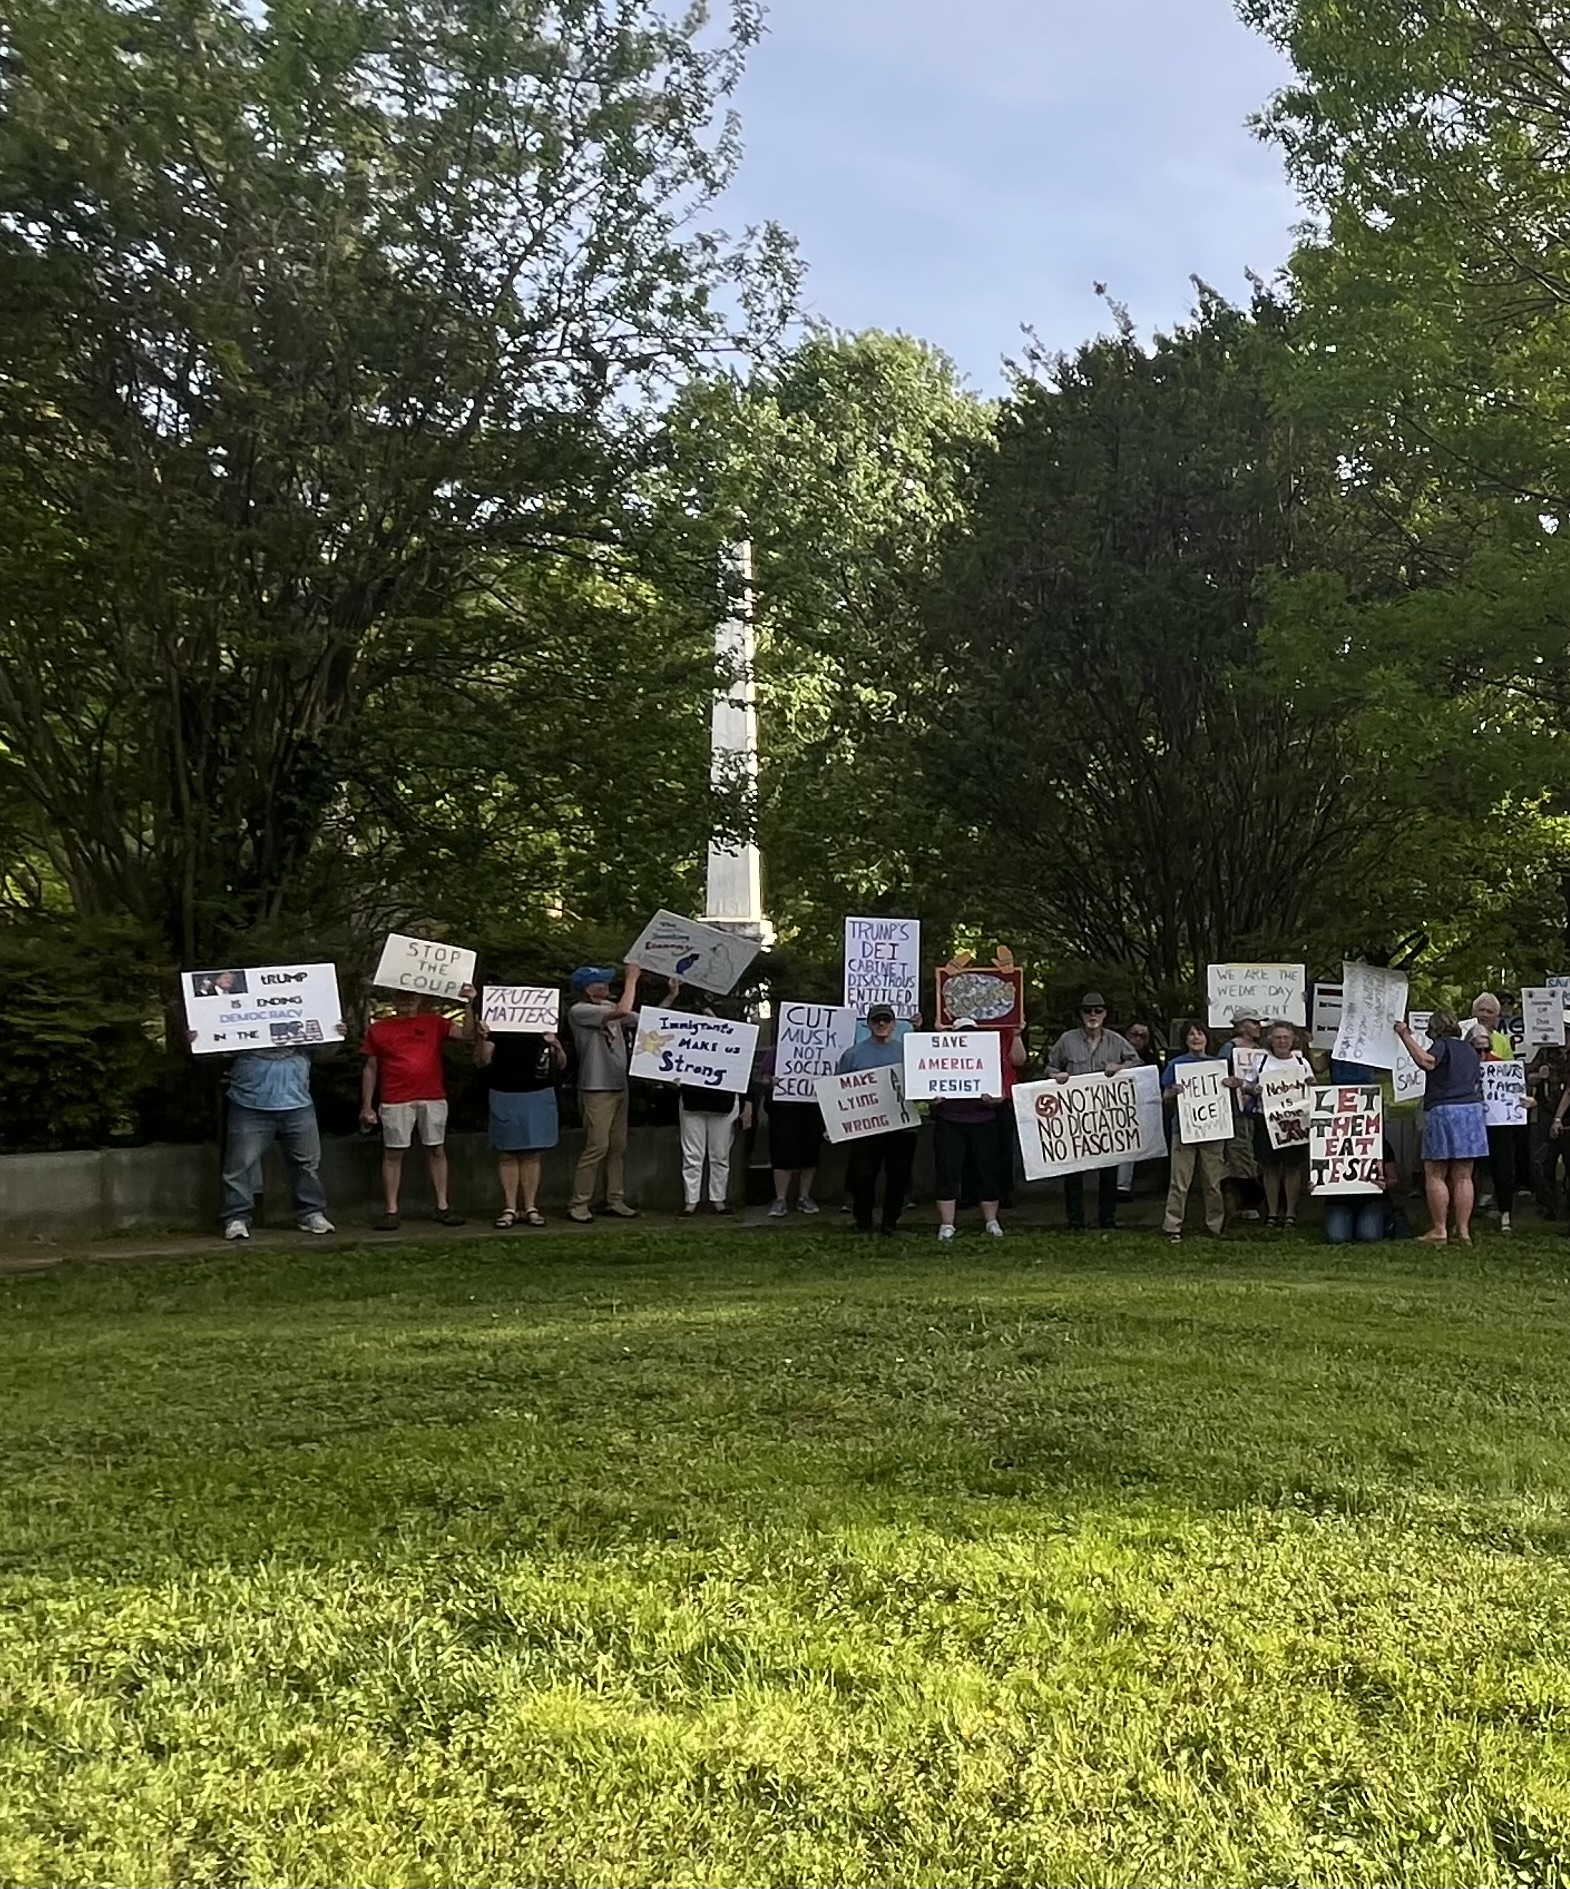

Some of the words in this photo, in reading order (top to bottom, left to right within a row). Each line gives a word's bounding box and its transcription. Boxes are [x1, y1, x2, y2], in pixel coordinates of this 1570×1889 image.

[848, 920, 910, 941] TRUMP'S
[406, 941, 461, 964] STOP
[862, 941, 900, 961] DEI
[417, 960, 450, 976] THE
[848, 958, 909, 976] CABINET
[1216, 968, 1235, 981] WE
[1244, 968, 1270, 981] ARE
[1278, 969, 1299, 981] THE
[400, 972, 457, 994] COUP
[230, 999, 242, 1009] IS
[486, 988, 554, 1005] TRUTH
[848, 987, 912, 1004] ENTITLED
[219, 1009, 304, 1024] DEMOCRACY
[484, 1006, 559, 1026] MATTERS
[786, 1006, 838, 1029] CUT
[659, 1017, 734, 1035] Immigrants
[214, 1032, 226, 1042] IN
[237, 1030, 260, 1041] THE
[678, 1038, 719, 1052] MAKE
[780, 1027, 838, 1048] MUSK
[931, 1035, 968, 1048] SAVE
[793, 1046, 825, 1061] NOT
[658, 1050, 728, 1086] Strong
[918, 1057, 984, 1070] AMERICA
[840, 1071, 878, 1090] MAKE
[928, 1079, 982, 1092] RESIST
[1181, 1072, 1220, 1100] MELT
[837, 1093, 879, 1112] LYING
[1057, 1089, 1086, 1116] NO
[1315, 1087, 1380, 1116] LET
[1192, 1102, 1218, 1122] ICE
[841, 1114, 890, 1134] WRONG
[1038, 1117, 1064, 1140] NO
[1067, 1106, 1140, 1138] DICTATOR
[1310, 1113, 1381, 1138] THEM
[1041, 1140, 1067, 1163] NO
[1072, 1128, 1141, 1159] FASCISM
[1325, 1138, 1375, 1157] EAT
